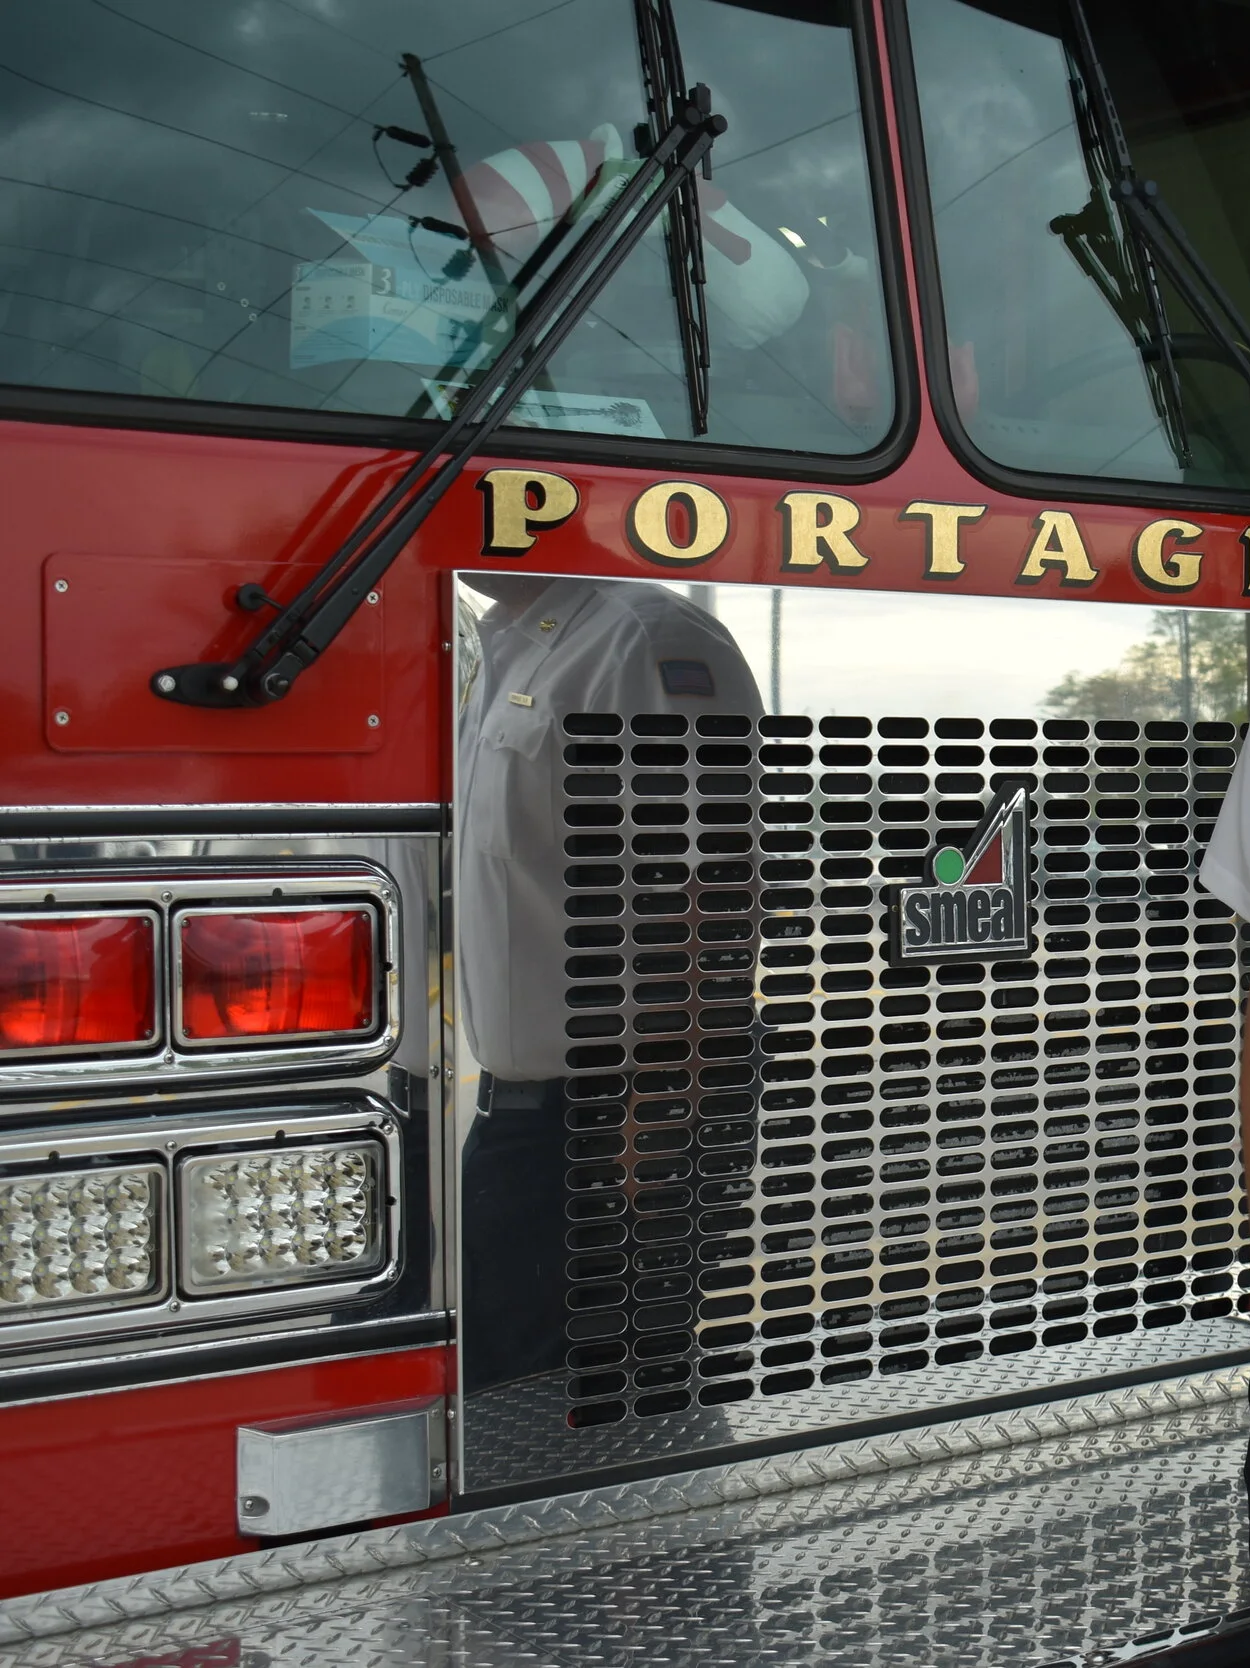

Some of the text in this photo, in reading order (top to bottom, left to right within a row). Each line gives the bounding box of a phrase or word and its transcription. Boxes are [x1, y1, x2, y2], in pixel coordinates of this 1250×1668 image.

[376, 268, 392, 294] 3
[423, 283, 481, 309] DISPOSABLE
[483, 294, 510, 313] MASK
